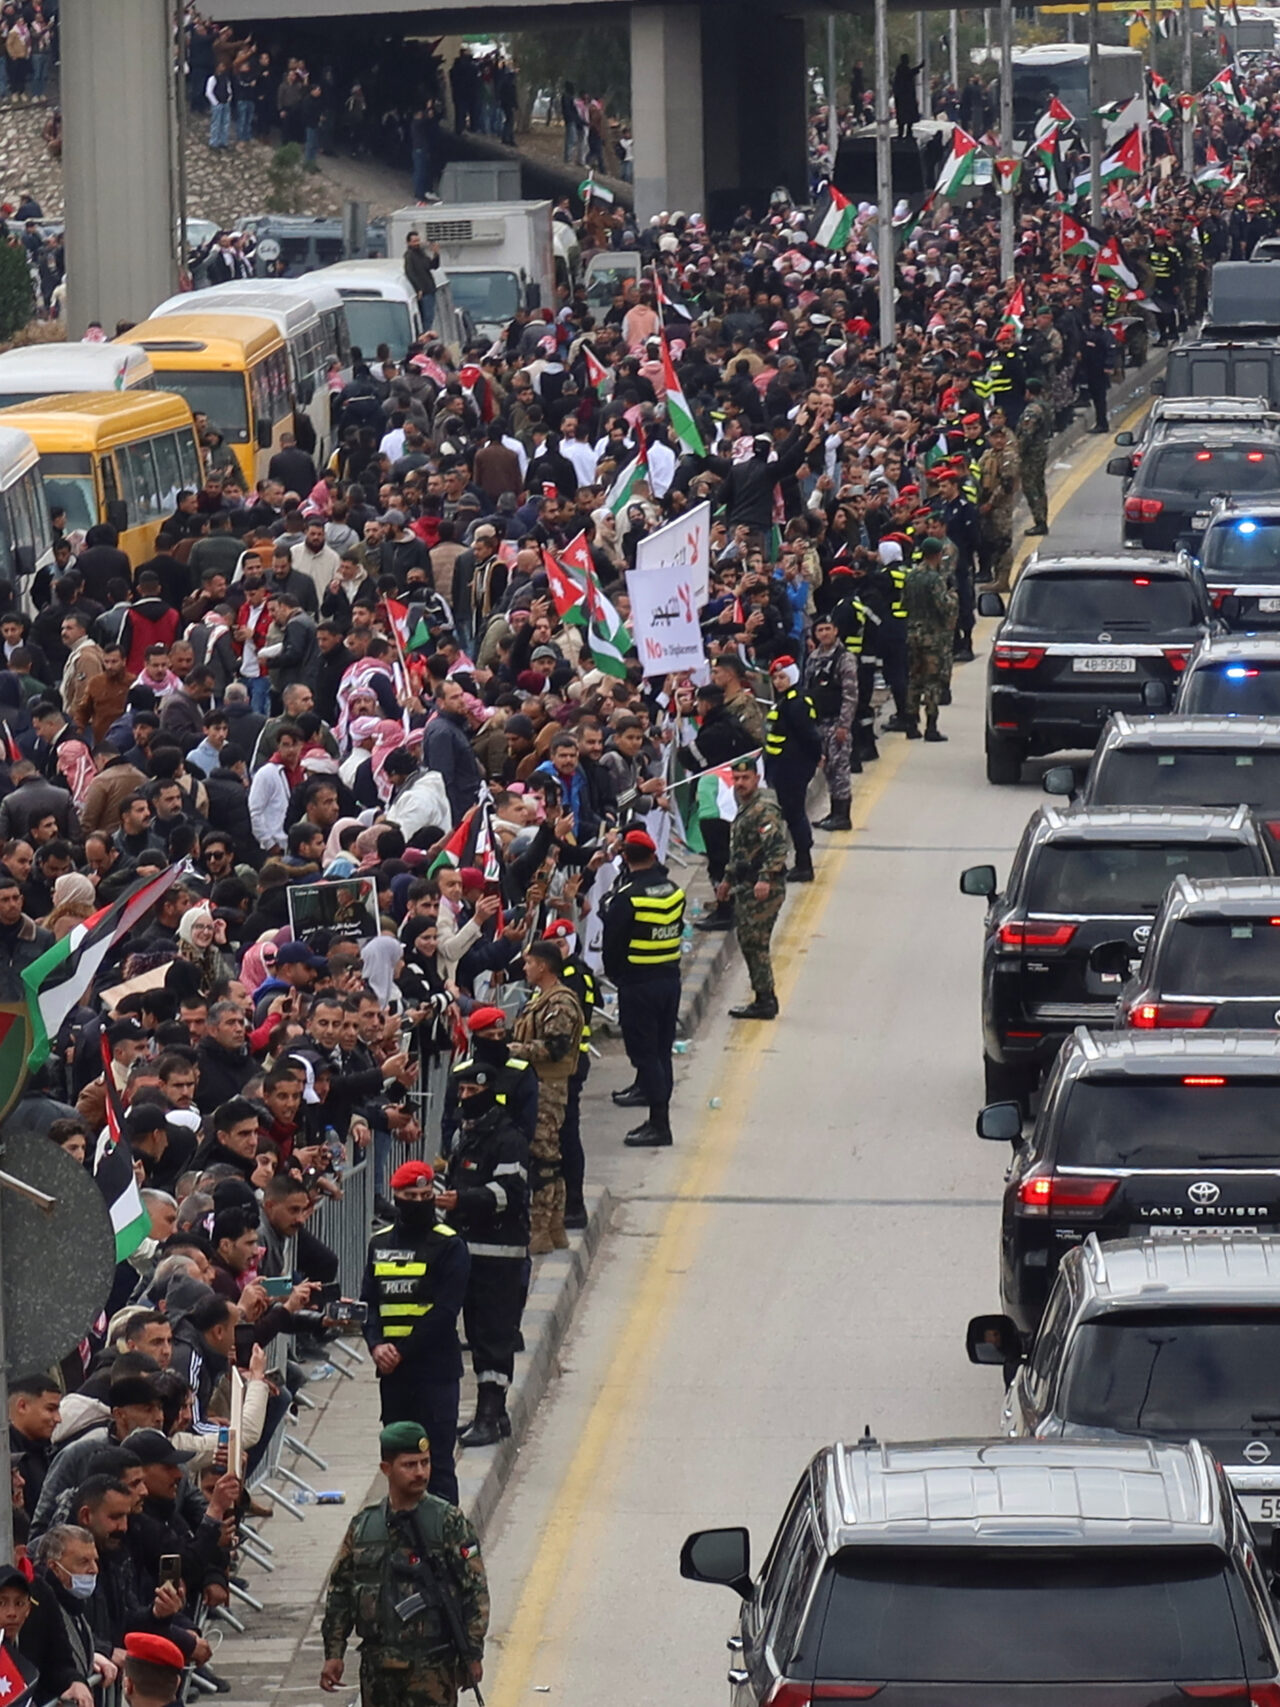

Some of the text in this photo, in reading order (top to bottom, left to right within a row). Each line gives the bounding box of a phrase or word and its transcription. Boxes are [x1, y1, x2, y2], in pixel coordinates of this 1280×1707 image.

[645, 637, 662, 659] No
[651, 924, 680, 940] POLICE
[1140, 1207, 1268, 1216] LAND CRUISER
